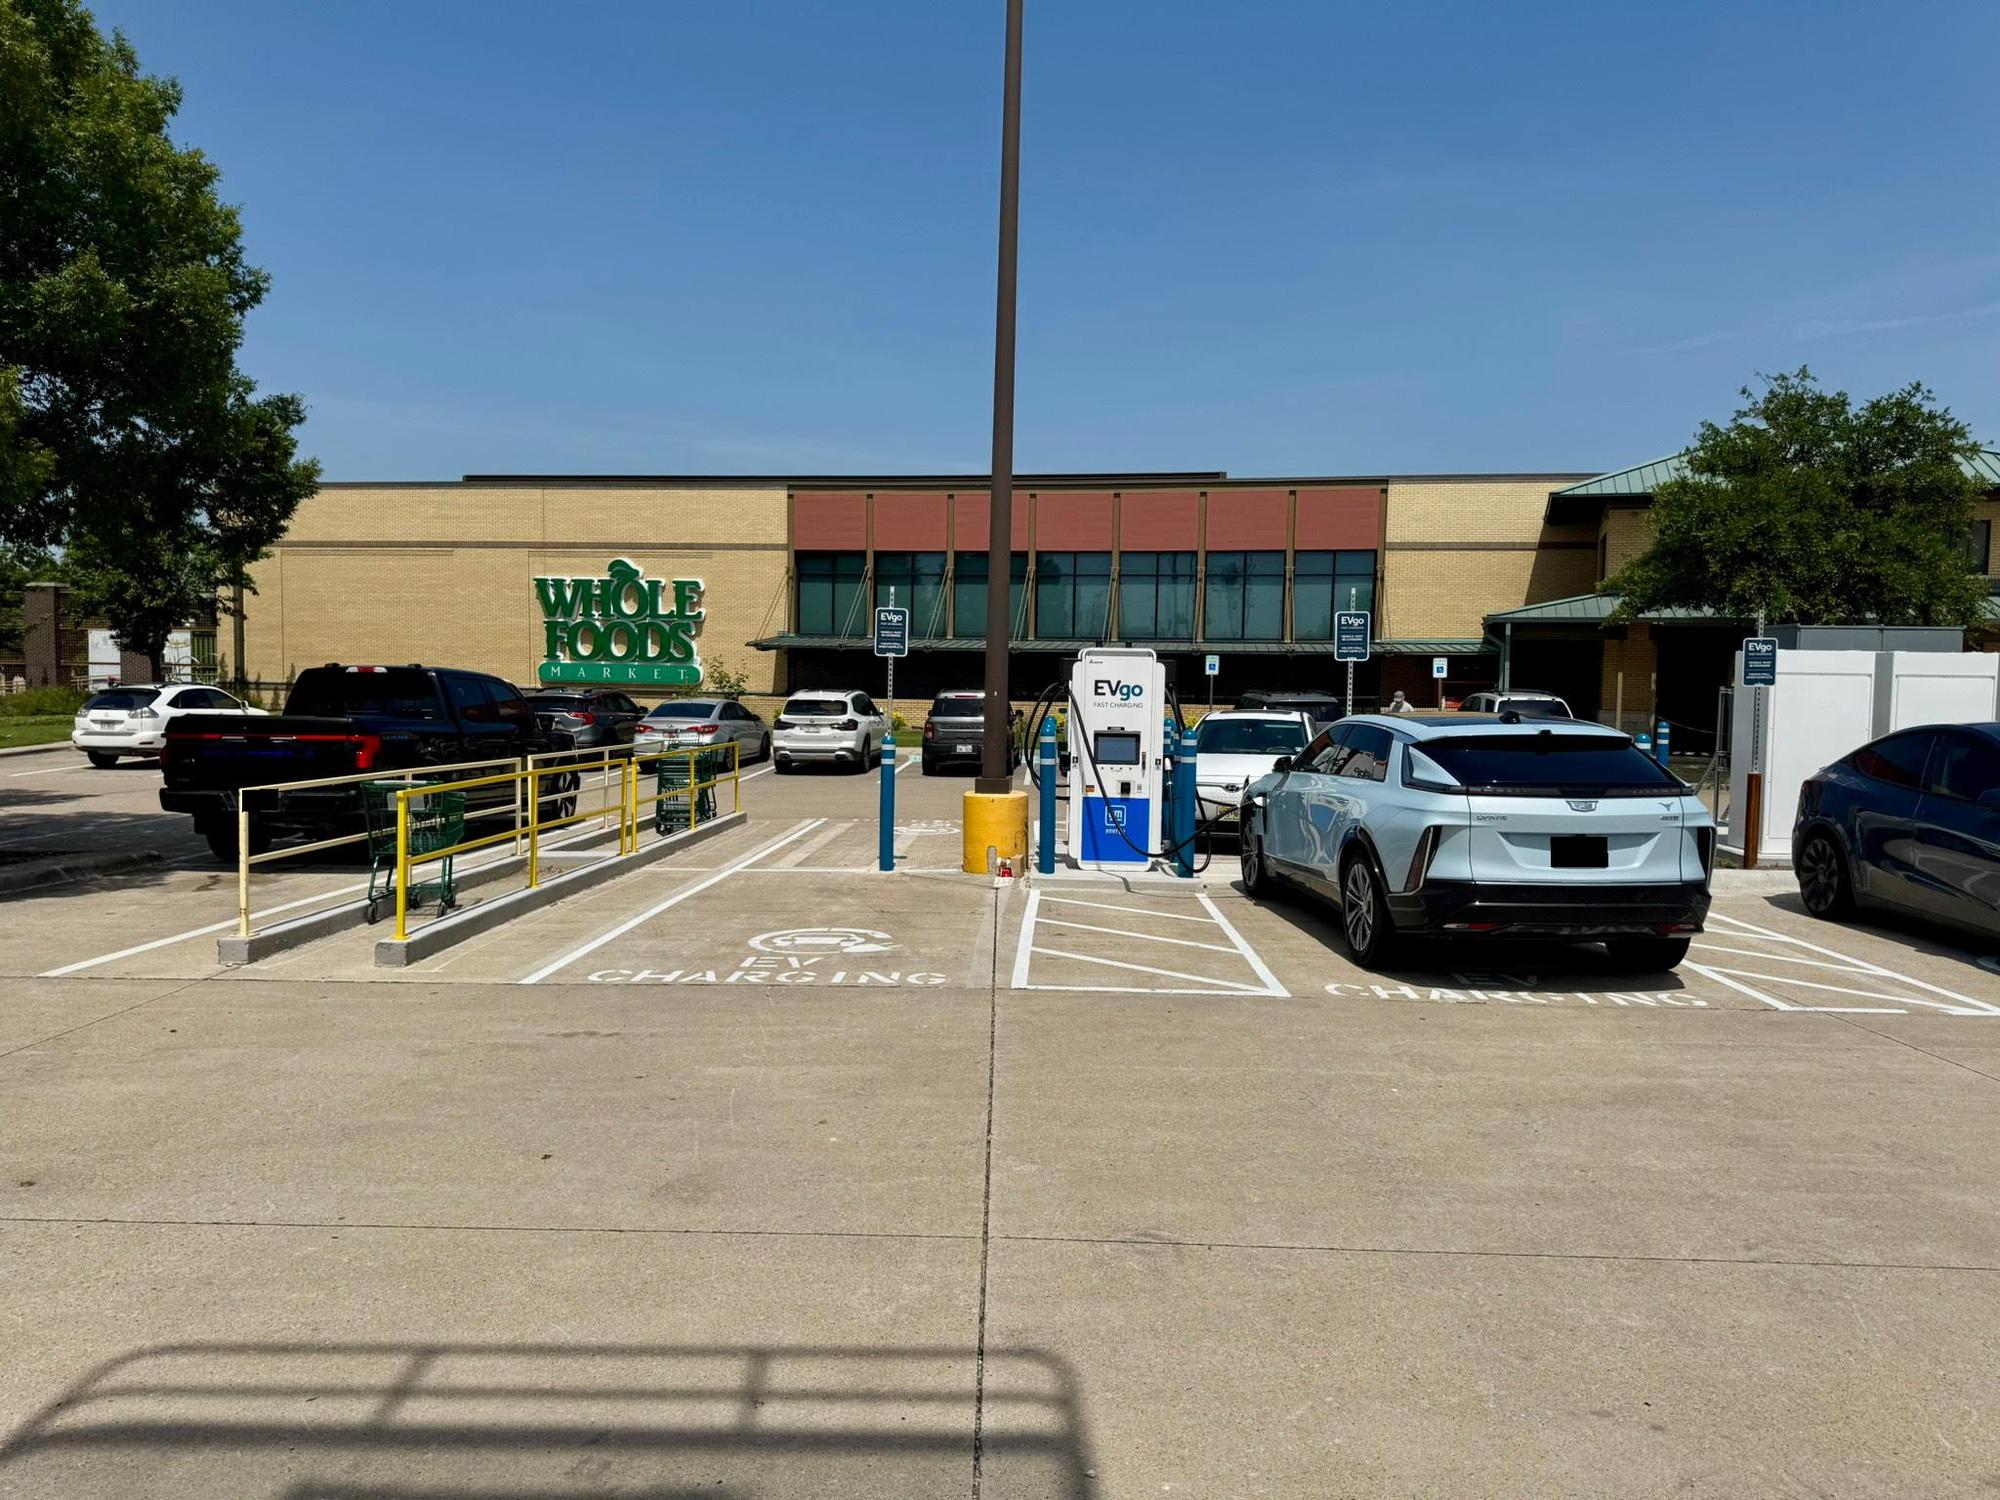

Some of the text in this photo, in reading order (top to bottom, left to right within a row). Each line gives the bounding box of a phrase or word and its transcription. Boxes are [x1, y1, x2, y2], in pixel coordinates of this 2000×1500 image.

[532, 575, 705, 620] WHOLE
[880, 612, 903, 623] EVgo
[1341, 616, 1365, 627] EVgo
[543, 619, 696, 663] FOODS
[1748, 642, 1773, 653] EVgo
[550, 666, 688, 681] MARKET
[1094, 679, 1144, 702] EVgo
[1093, 701, 1109, 709] FAST
[739, 956, 825, 969] EV
[586, 969, 949, 985] CHARGING
